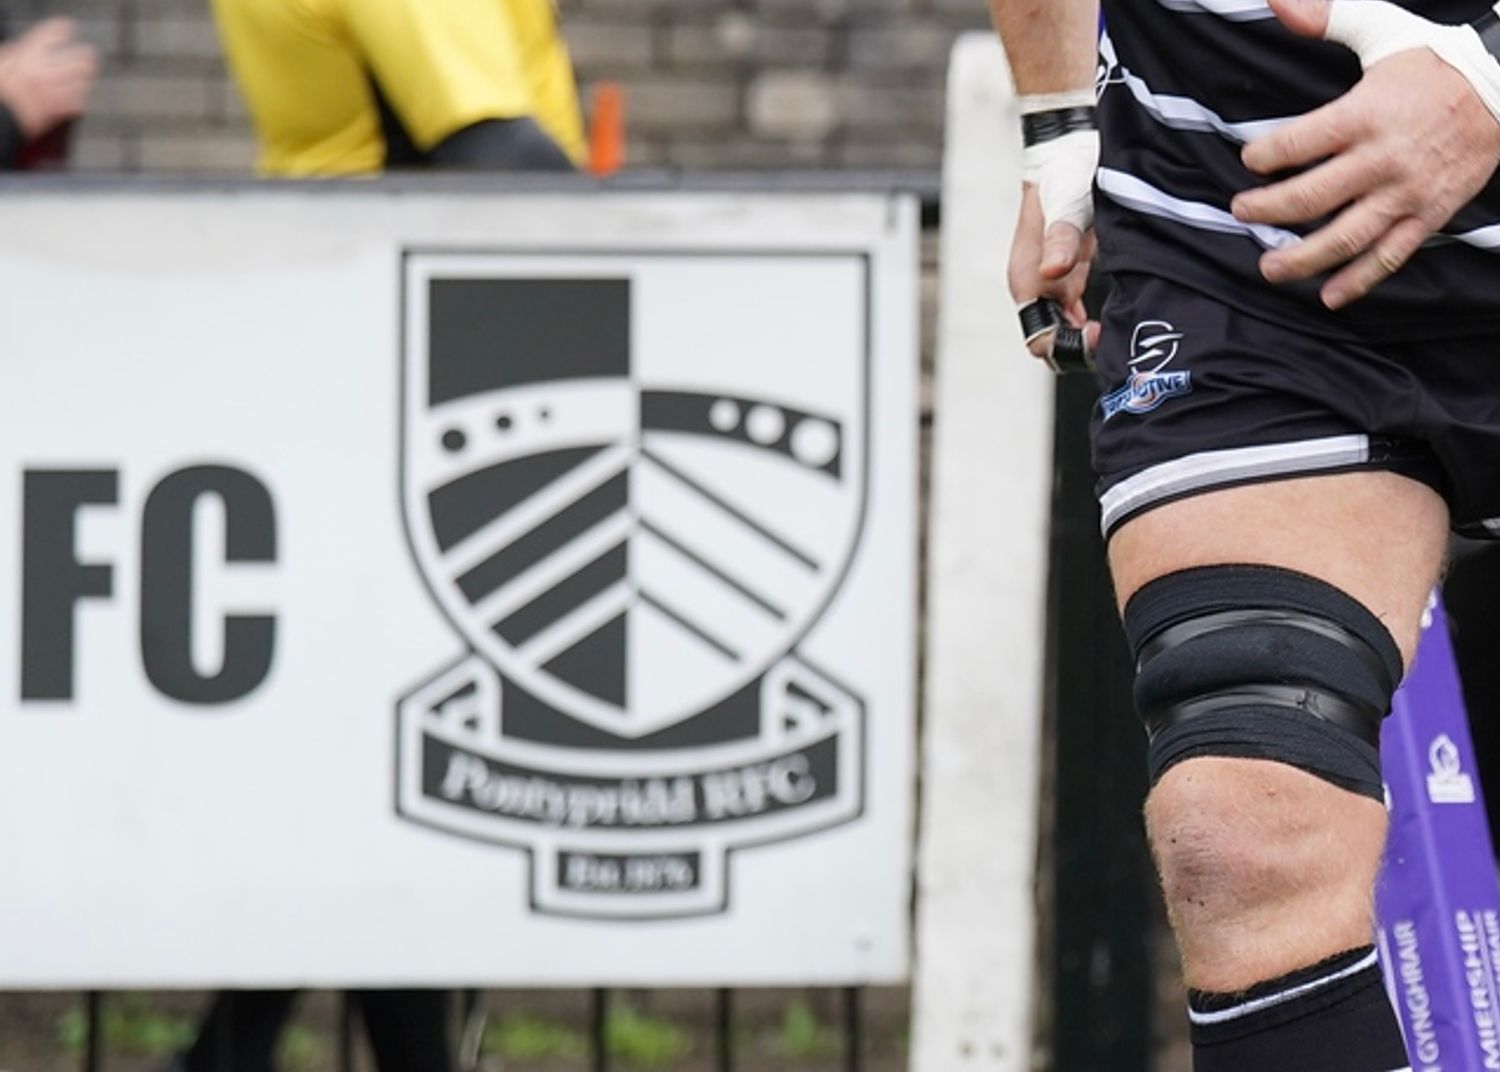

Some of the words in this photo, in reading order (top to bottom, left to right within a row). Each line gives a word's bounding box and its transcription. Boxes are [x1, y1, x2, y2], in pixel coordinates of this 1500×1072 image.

[18, 464, 280, 708] FC
[441, 751, 697, 828] Pontypridd
[702, 753, 816, 820] RFC
